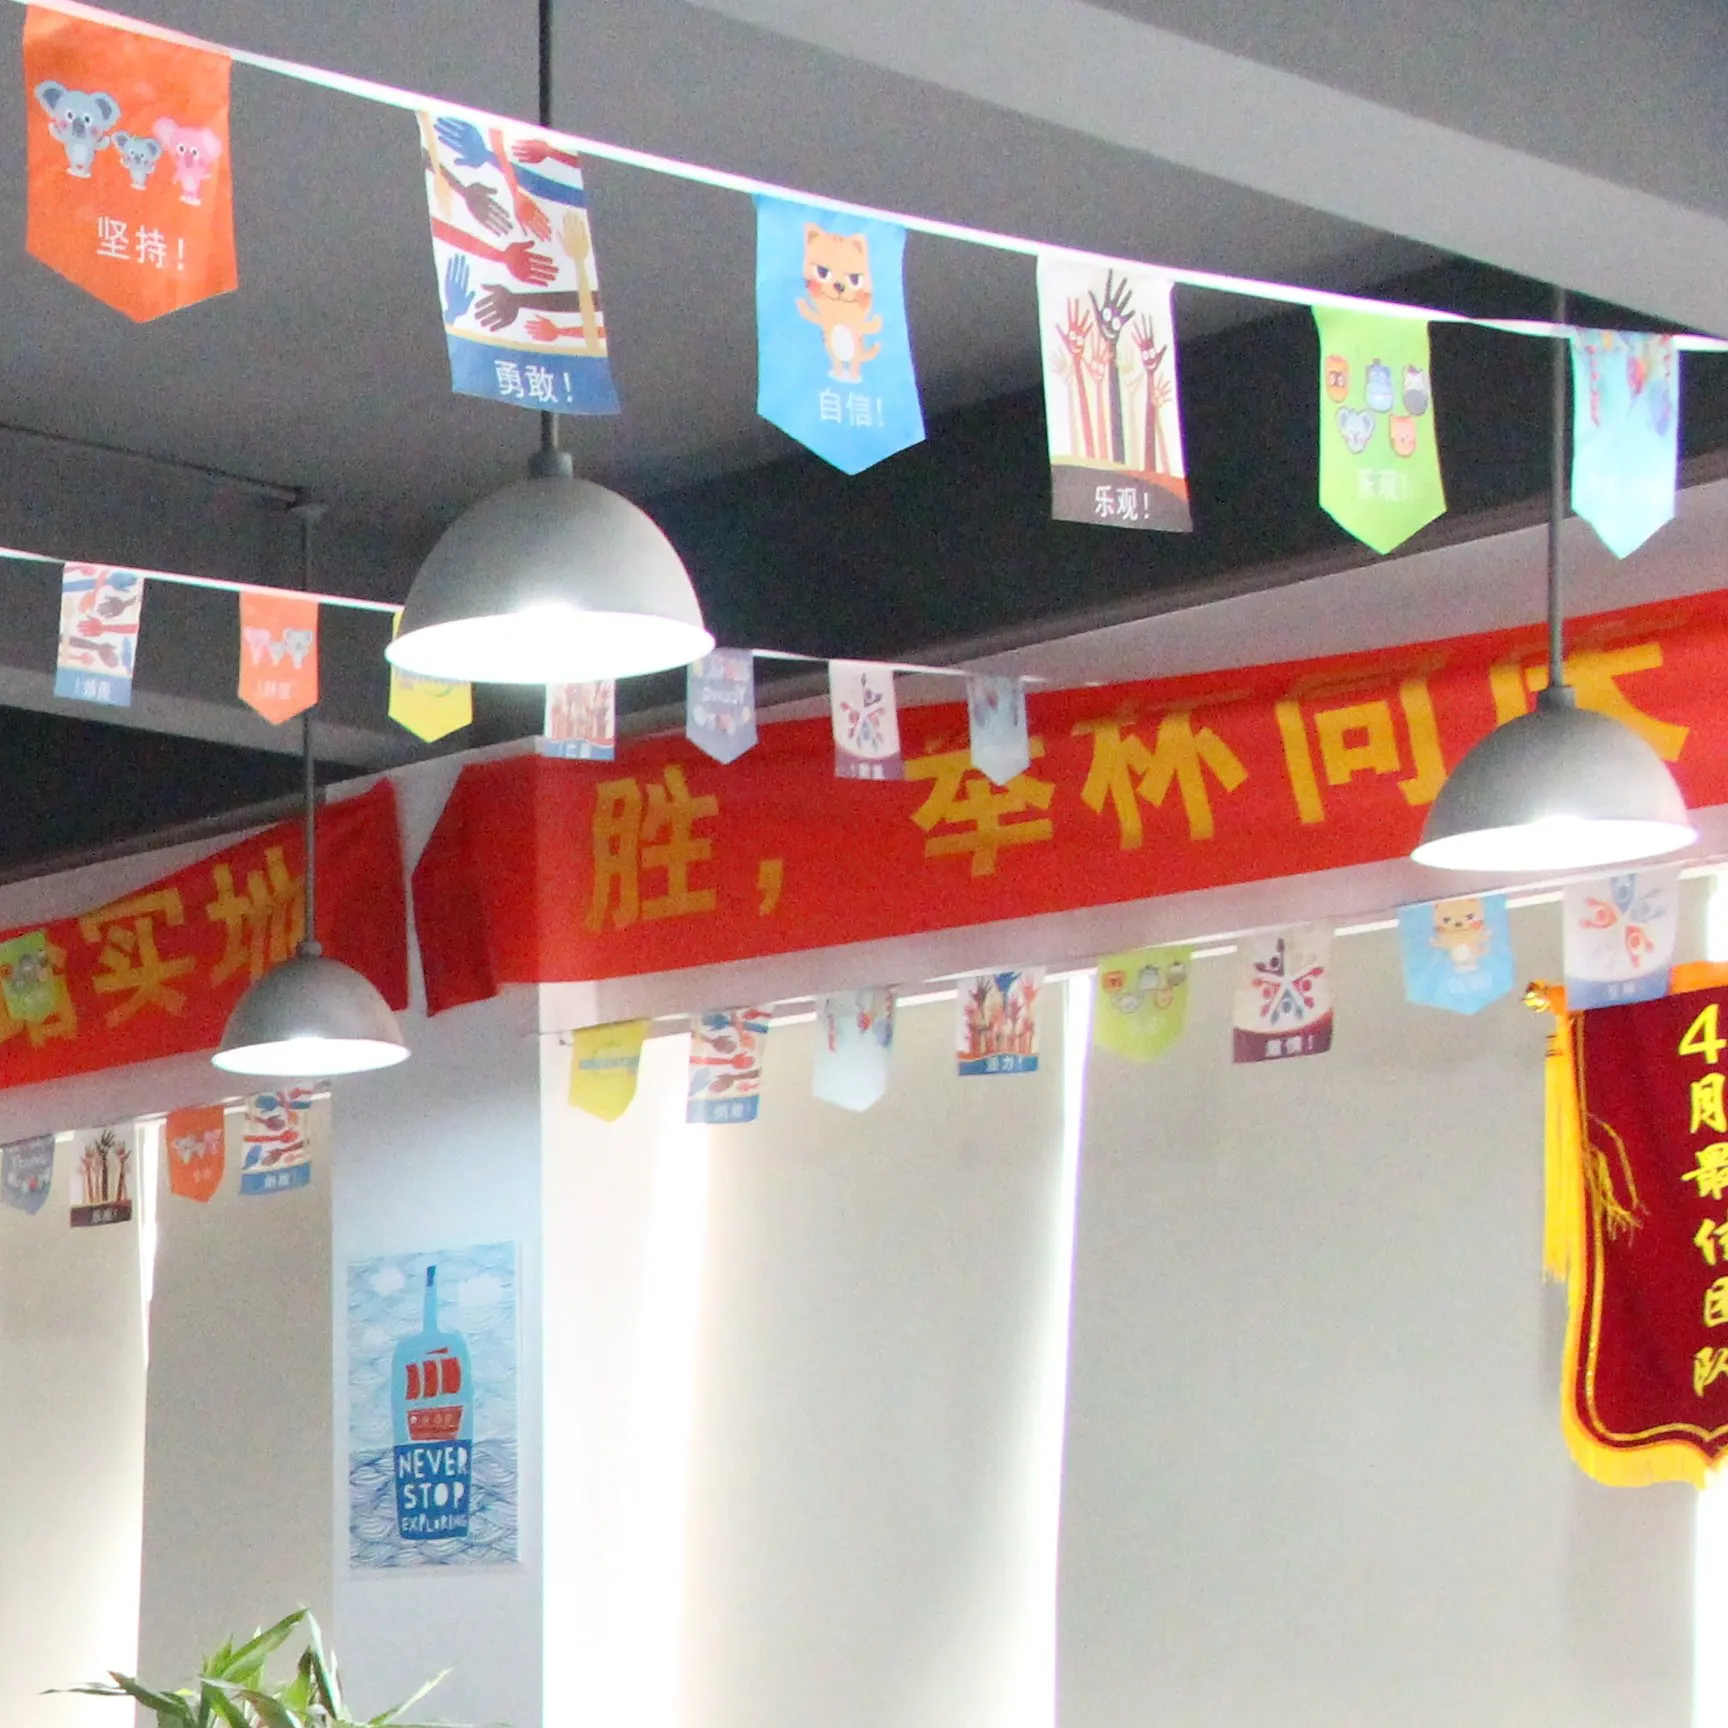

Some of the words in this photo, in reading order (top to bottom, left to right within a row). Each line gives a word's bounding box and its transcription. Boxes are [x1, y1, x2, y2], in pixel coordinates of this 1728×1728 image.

[96, 215, 187, 272] 坚持!
[493, 359, 575, 404] 勇敢!
[817, 388, 885, 429] 自信!
[1092, 484, 1153, 521] 乐观!
[399, 1446, 469, 1478] NEVER
[403, 1481, 465, 1509] STOP
[402, 1513, 468, 1532] EXPLORING
